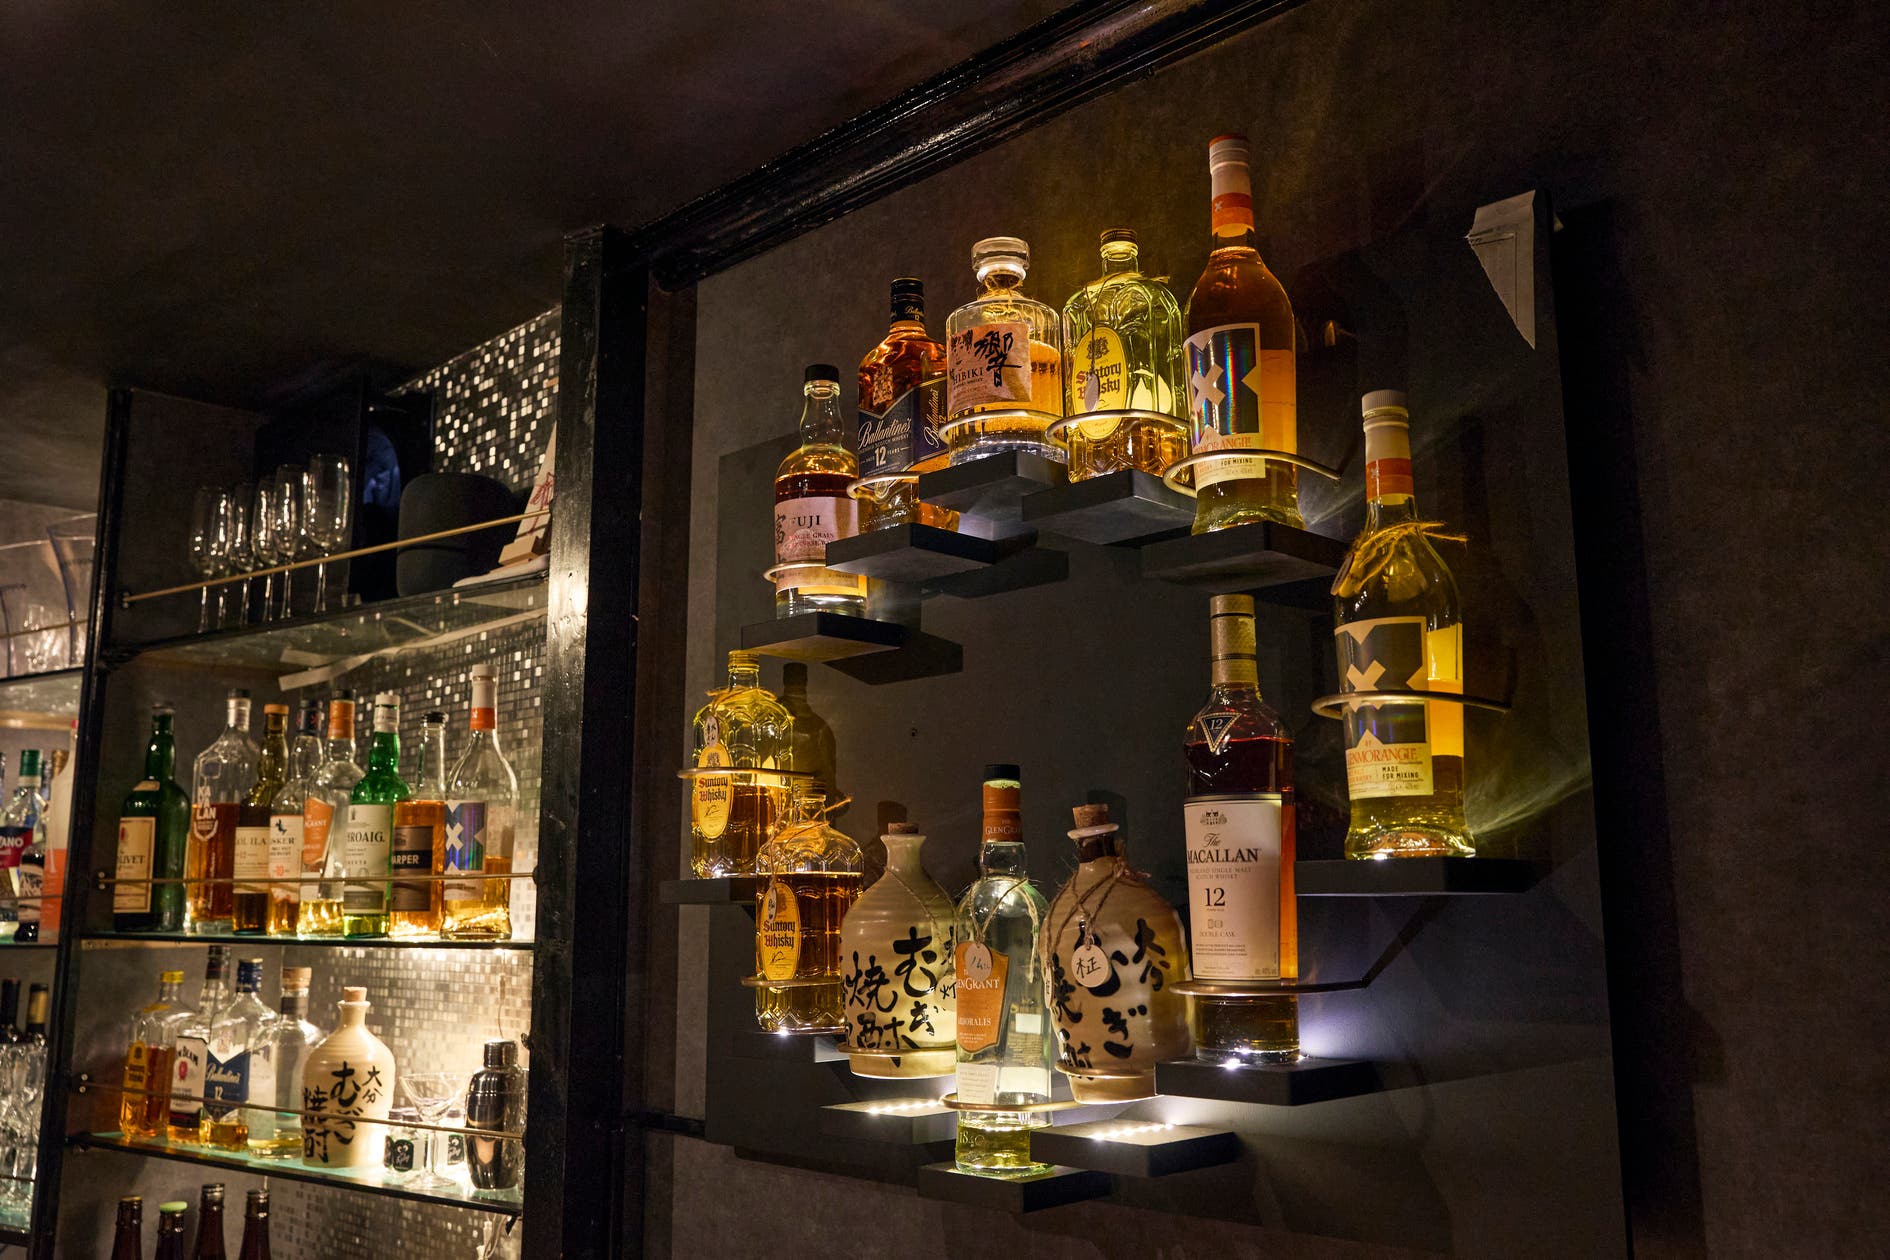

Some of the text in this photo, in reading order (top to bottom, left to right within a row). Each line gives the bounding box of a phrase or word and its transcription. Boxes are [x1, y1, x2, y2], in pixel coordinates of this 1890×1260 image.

[953, 367, 984, 385] HIBIKI
[857, 417, 912, 450] Ballantine's
[875, 446, 886, 467] 12
[1210, 719, 1223, 730] 12
[699, 776, 728, 789] Suntory
[1397, 771, 1419, 779] MIXING
[699, 789, 727, 802] Whisky
[196, 807, 216, 819] LAN
[1203, 832, 1222, 848] The
[1187, 848, 1259, 864] MACALLAN
[1204, 887, 1226, 907] 12
[763, 920, 796, 935] Suntory
[764, 933, 795, 949] Whisky
